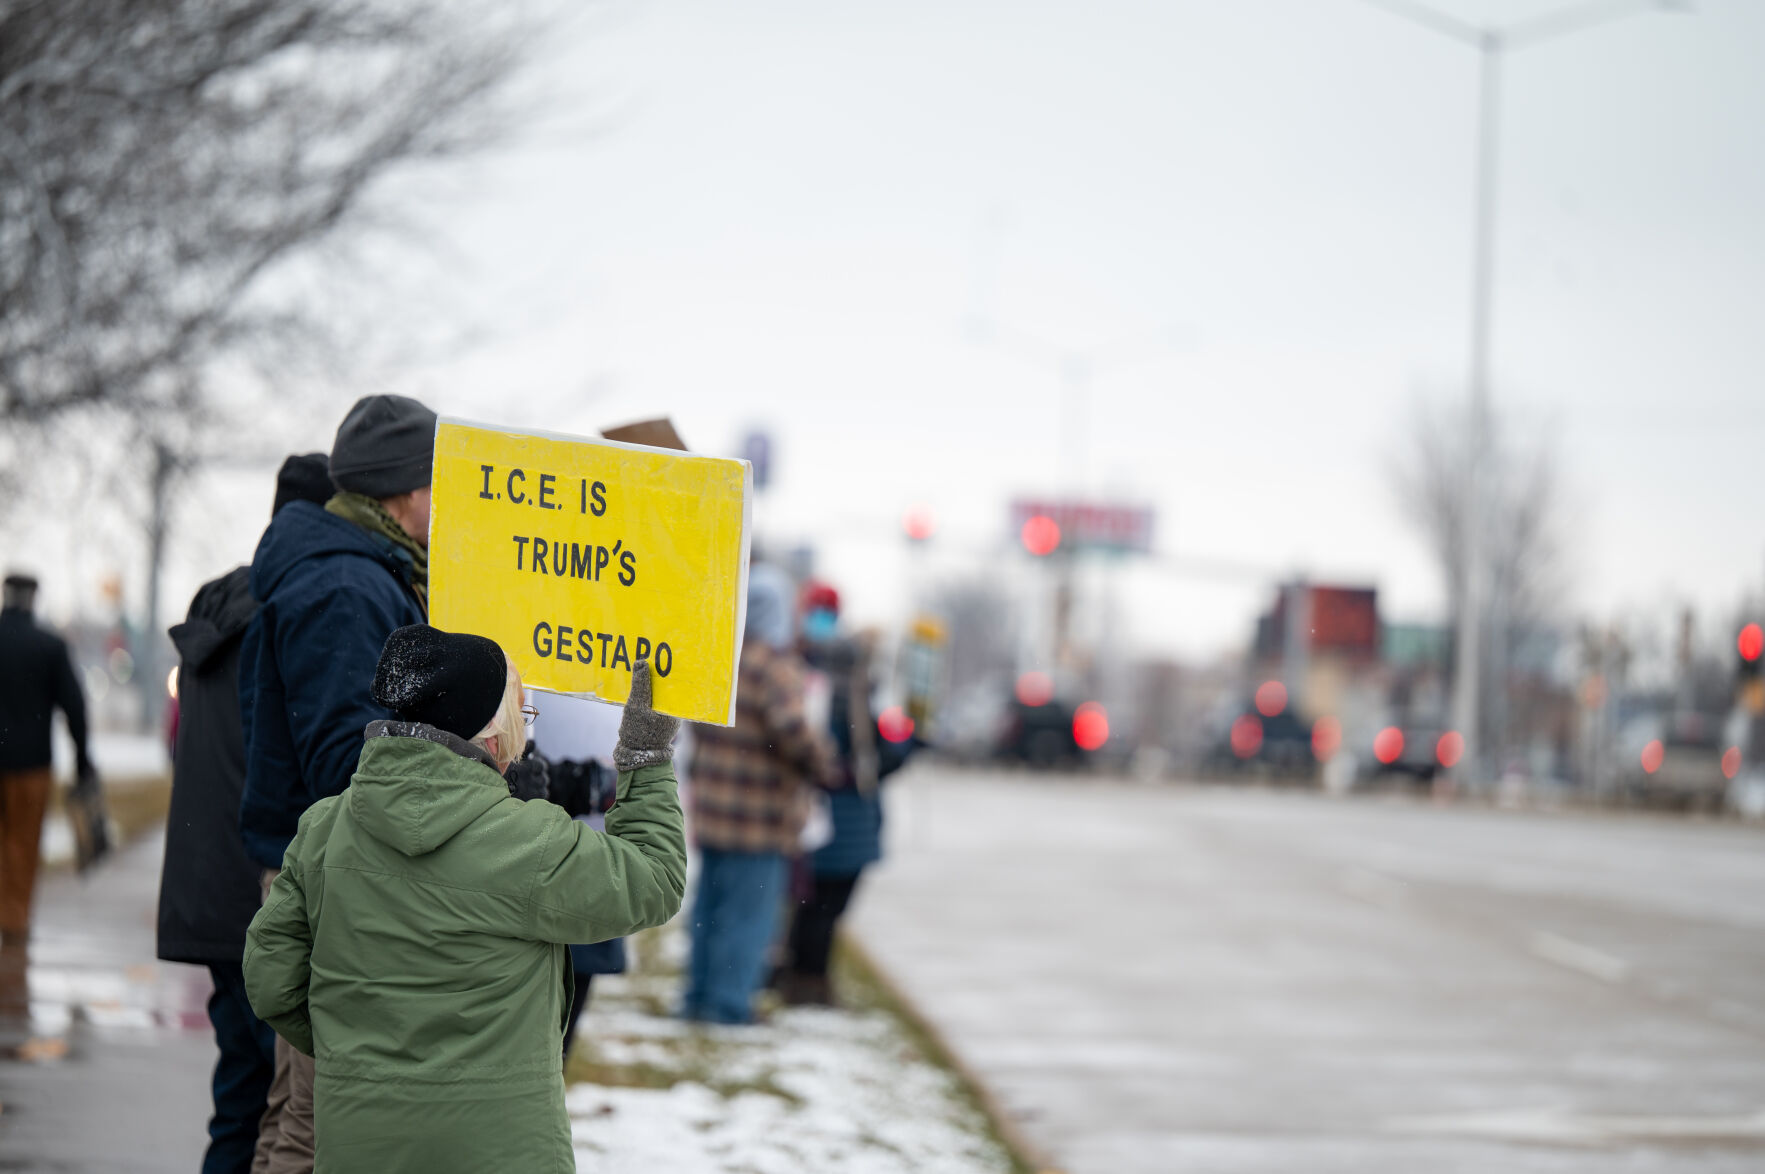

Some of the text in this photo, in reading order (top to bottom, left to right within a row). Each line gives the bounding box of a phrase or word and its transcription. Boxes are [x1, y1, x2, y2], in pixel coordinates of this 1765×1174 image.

[480, 465, 607, 517] I.C.E. IS
[513, 535, 636, 587] TRUMP'S
